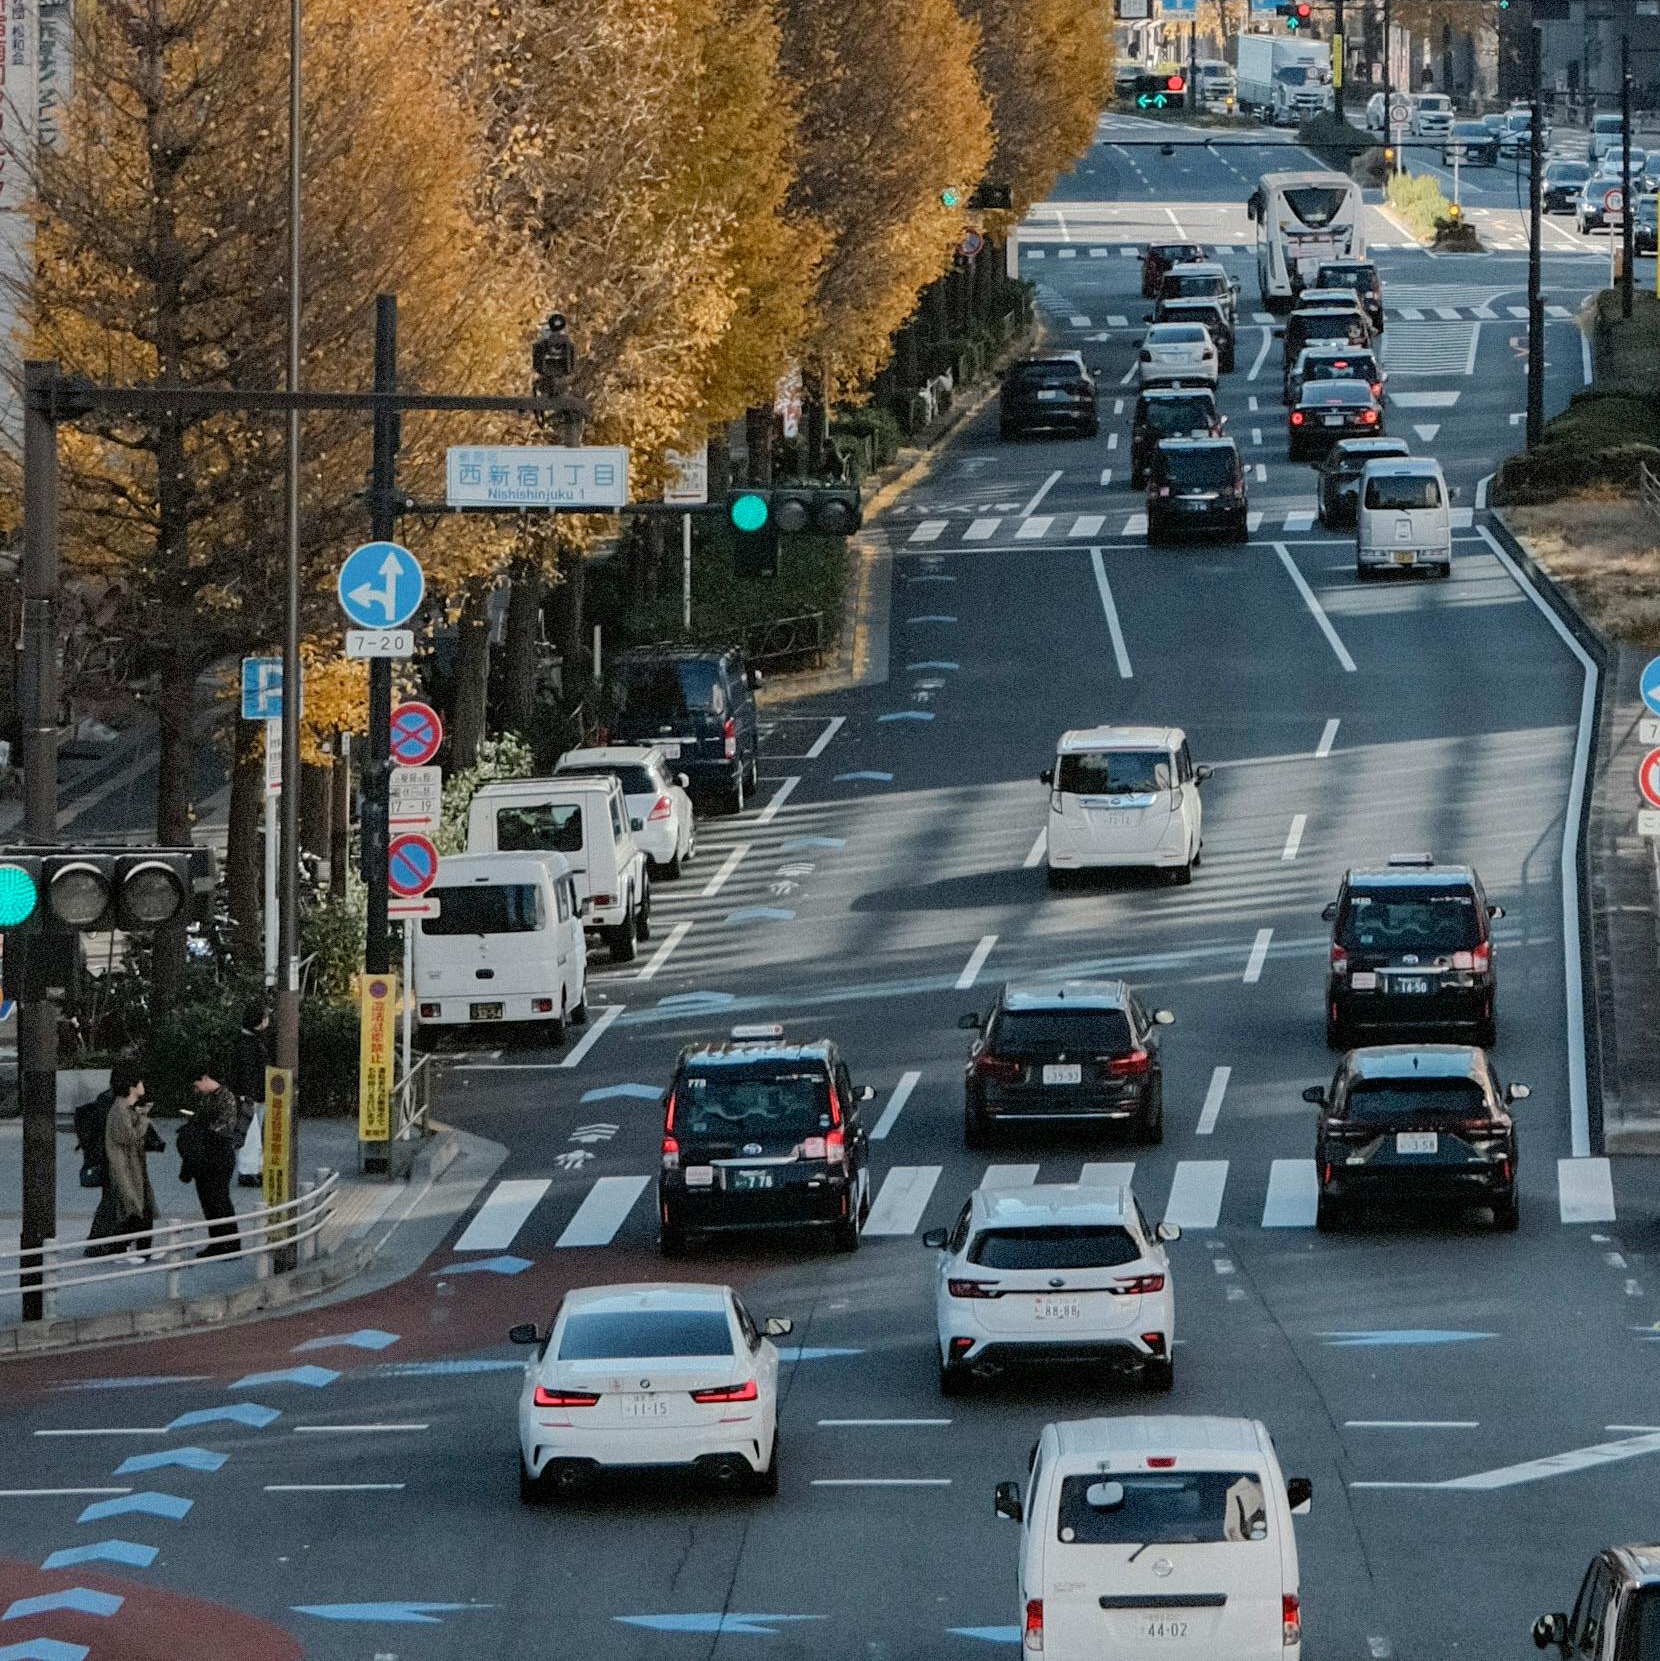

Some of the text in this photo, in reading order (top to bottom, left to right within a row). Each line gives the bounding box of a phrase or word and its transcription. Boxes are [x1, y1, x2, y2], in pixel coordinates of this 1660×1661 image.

[459, 463, 615, 487] 西新宿1丁目
[487, 488, 574, 502] Nishishinjuku
[354, 636, 405, 651] 7-20
